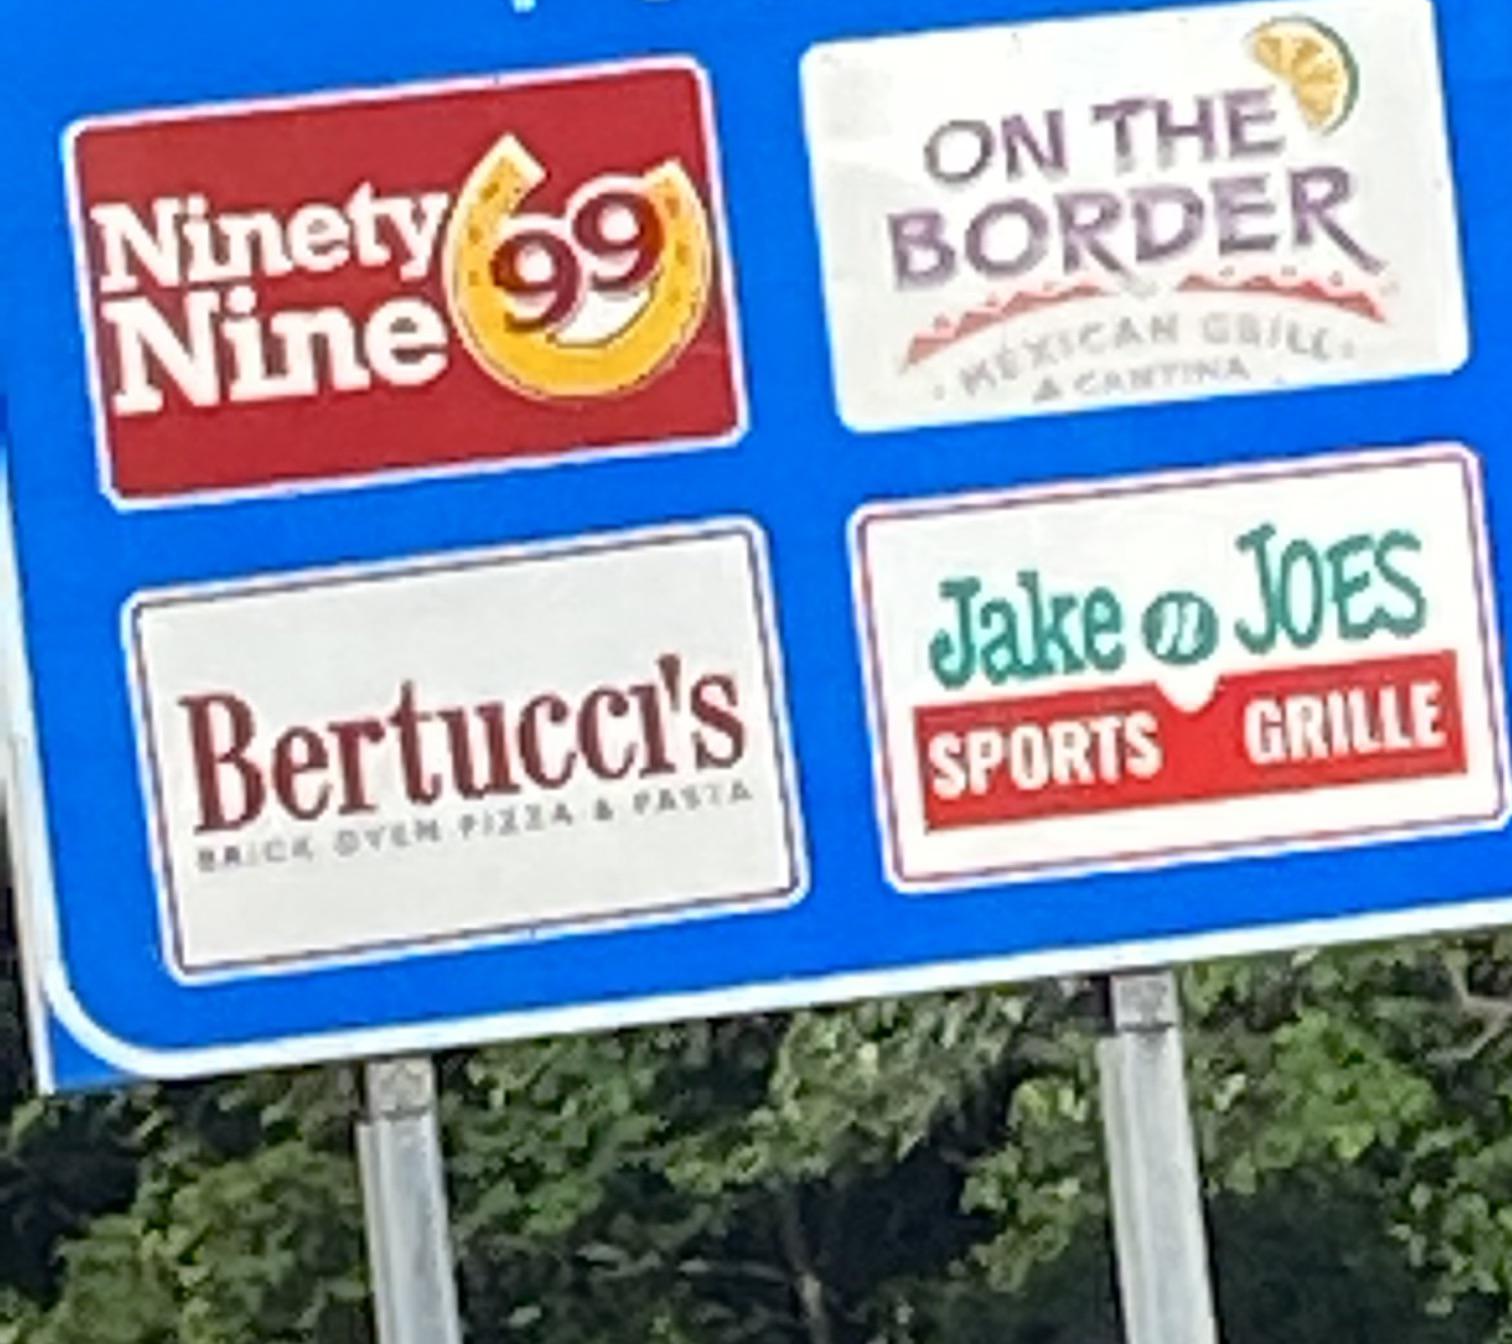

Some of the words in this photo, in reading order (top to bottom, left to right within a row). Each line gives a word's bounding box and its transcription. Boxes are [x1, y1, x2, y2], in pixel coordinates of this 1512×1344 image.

[923, 108, 1070, 187] ON
[1090, 84, 1286, 174] THE
[90, 182, 450, 295] Ninety
[488, 190, 666, 334] 99
[886, 164, 1391, 298] BORDER
[103, 285, 449, 416] Nine
[928, 569, 1126, 690] Jake
[1234, 521, 1428, 656] JOES
[178, 653, 746, 837] Bertucci's
[926, 711, 1163, 800] SPORTS
[1242, 680, 1449, 766] GRILLE
[458, 802, 573, 839] PIZZA
[632, 779, 752, 815] PASTA
